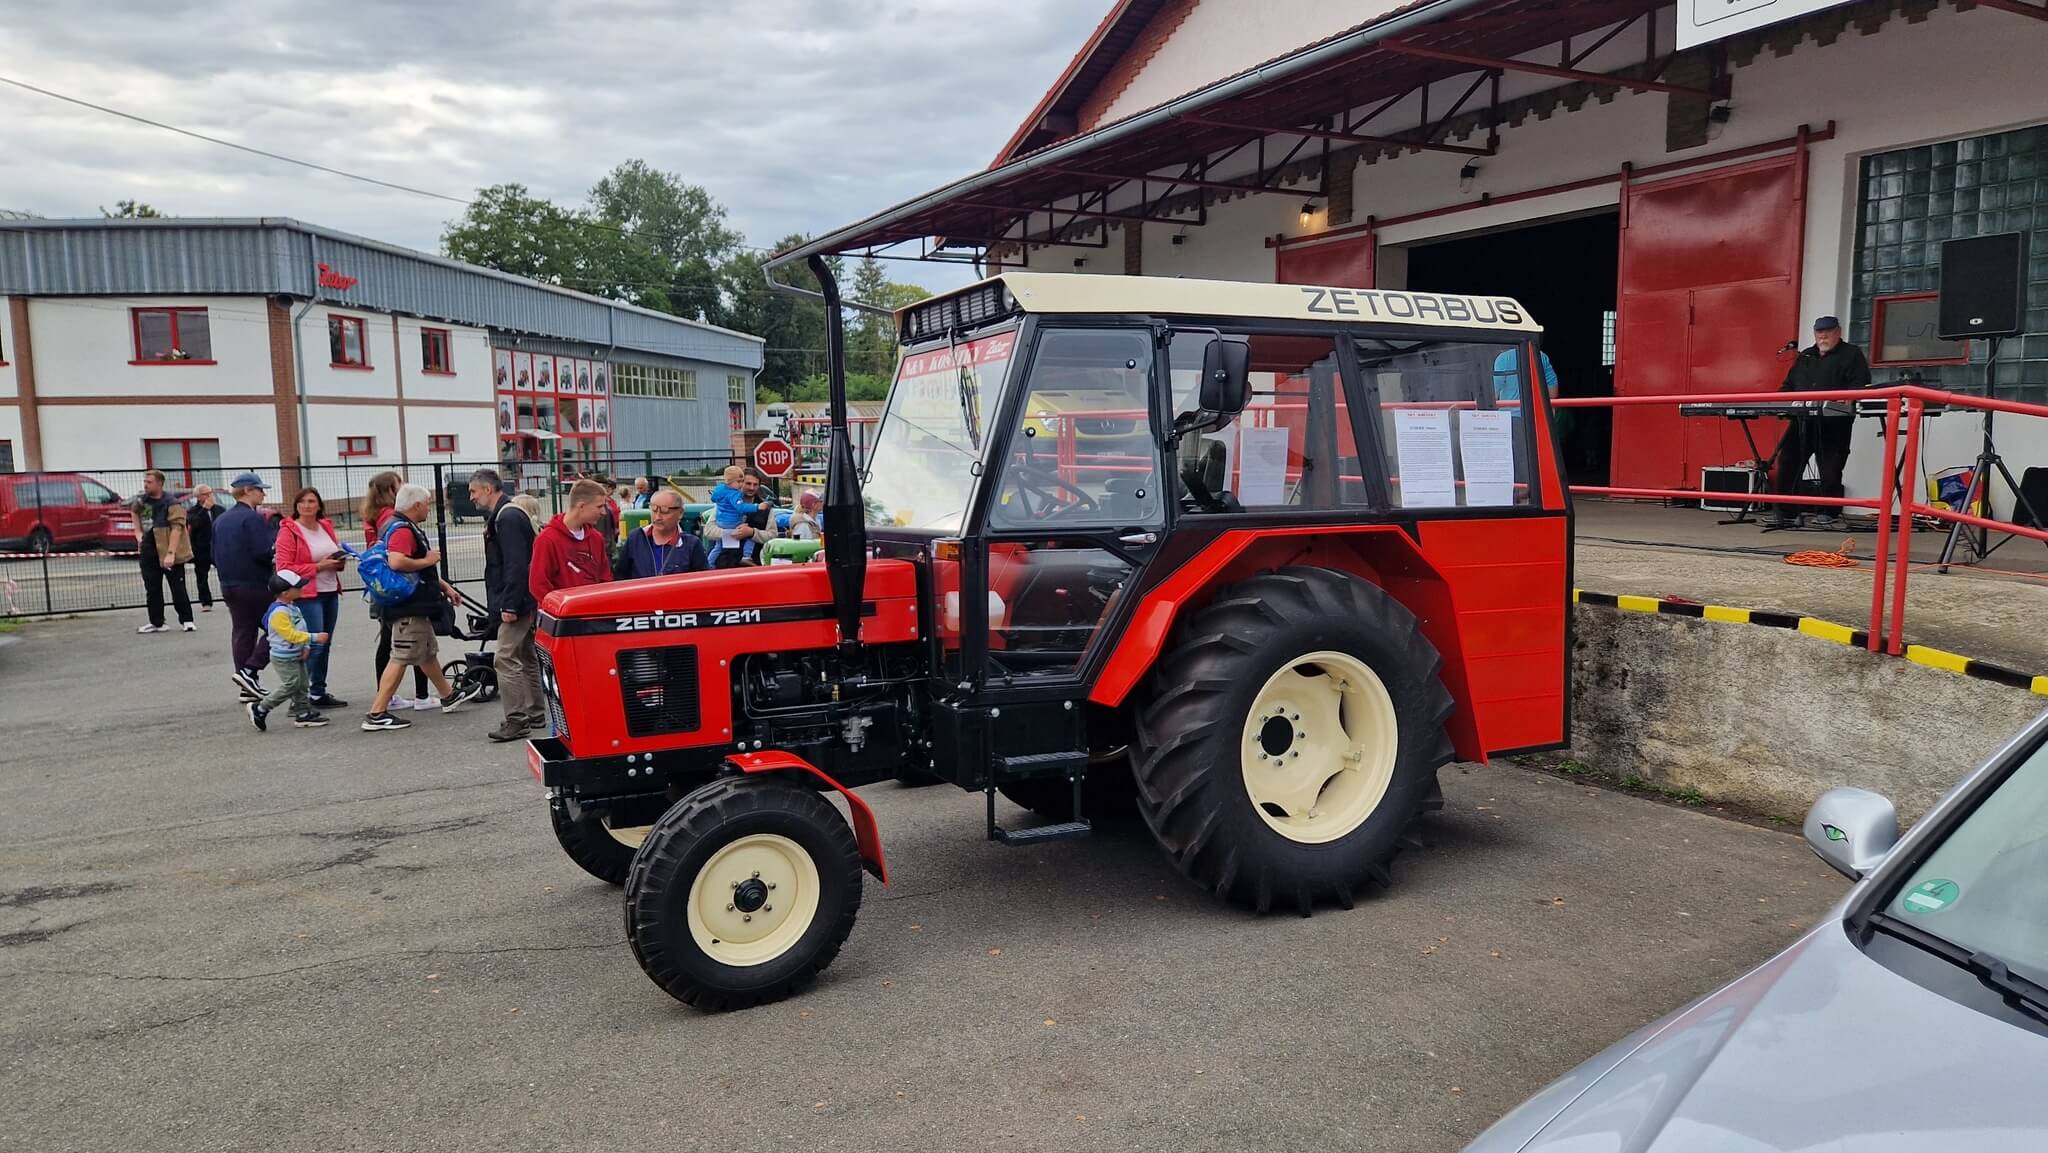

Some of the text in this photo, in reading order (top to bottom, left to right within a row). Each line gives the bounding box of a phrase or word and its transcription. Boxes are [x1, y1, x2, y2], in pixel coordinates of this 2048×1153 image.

[1301, 287, 1523, 324] ZETORBUS
[759, 450, 788, 465] STOP
[615, 609, 761, 631] ZETOR 7211
